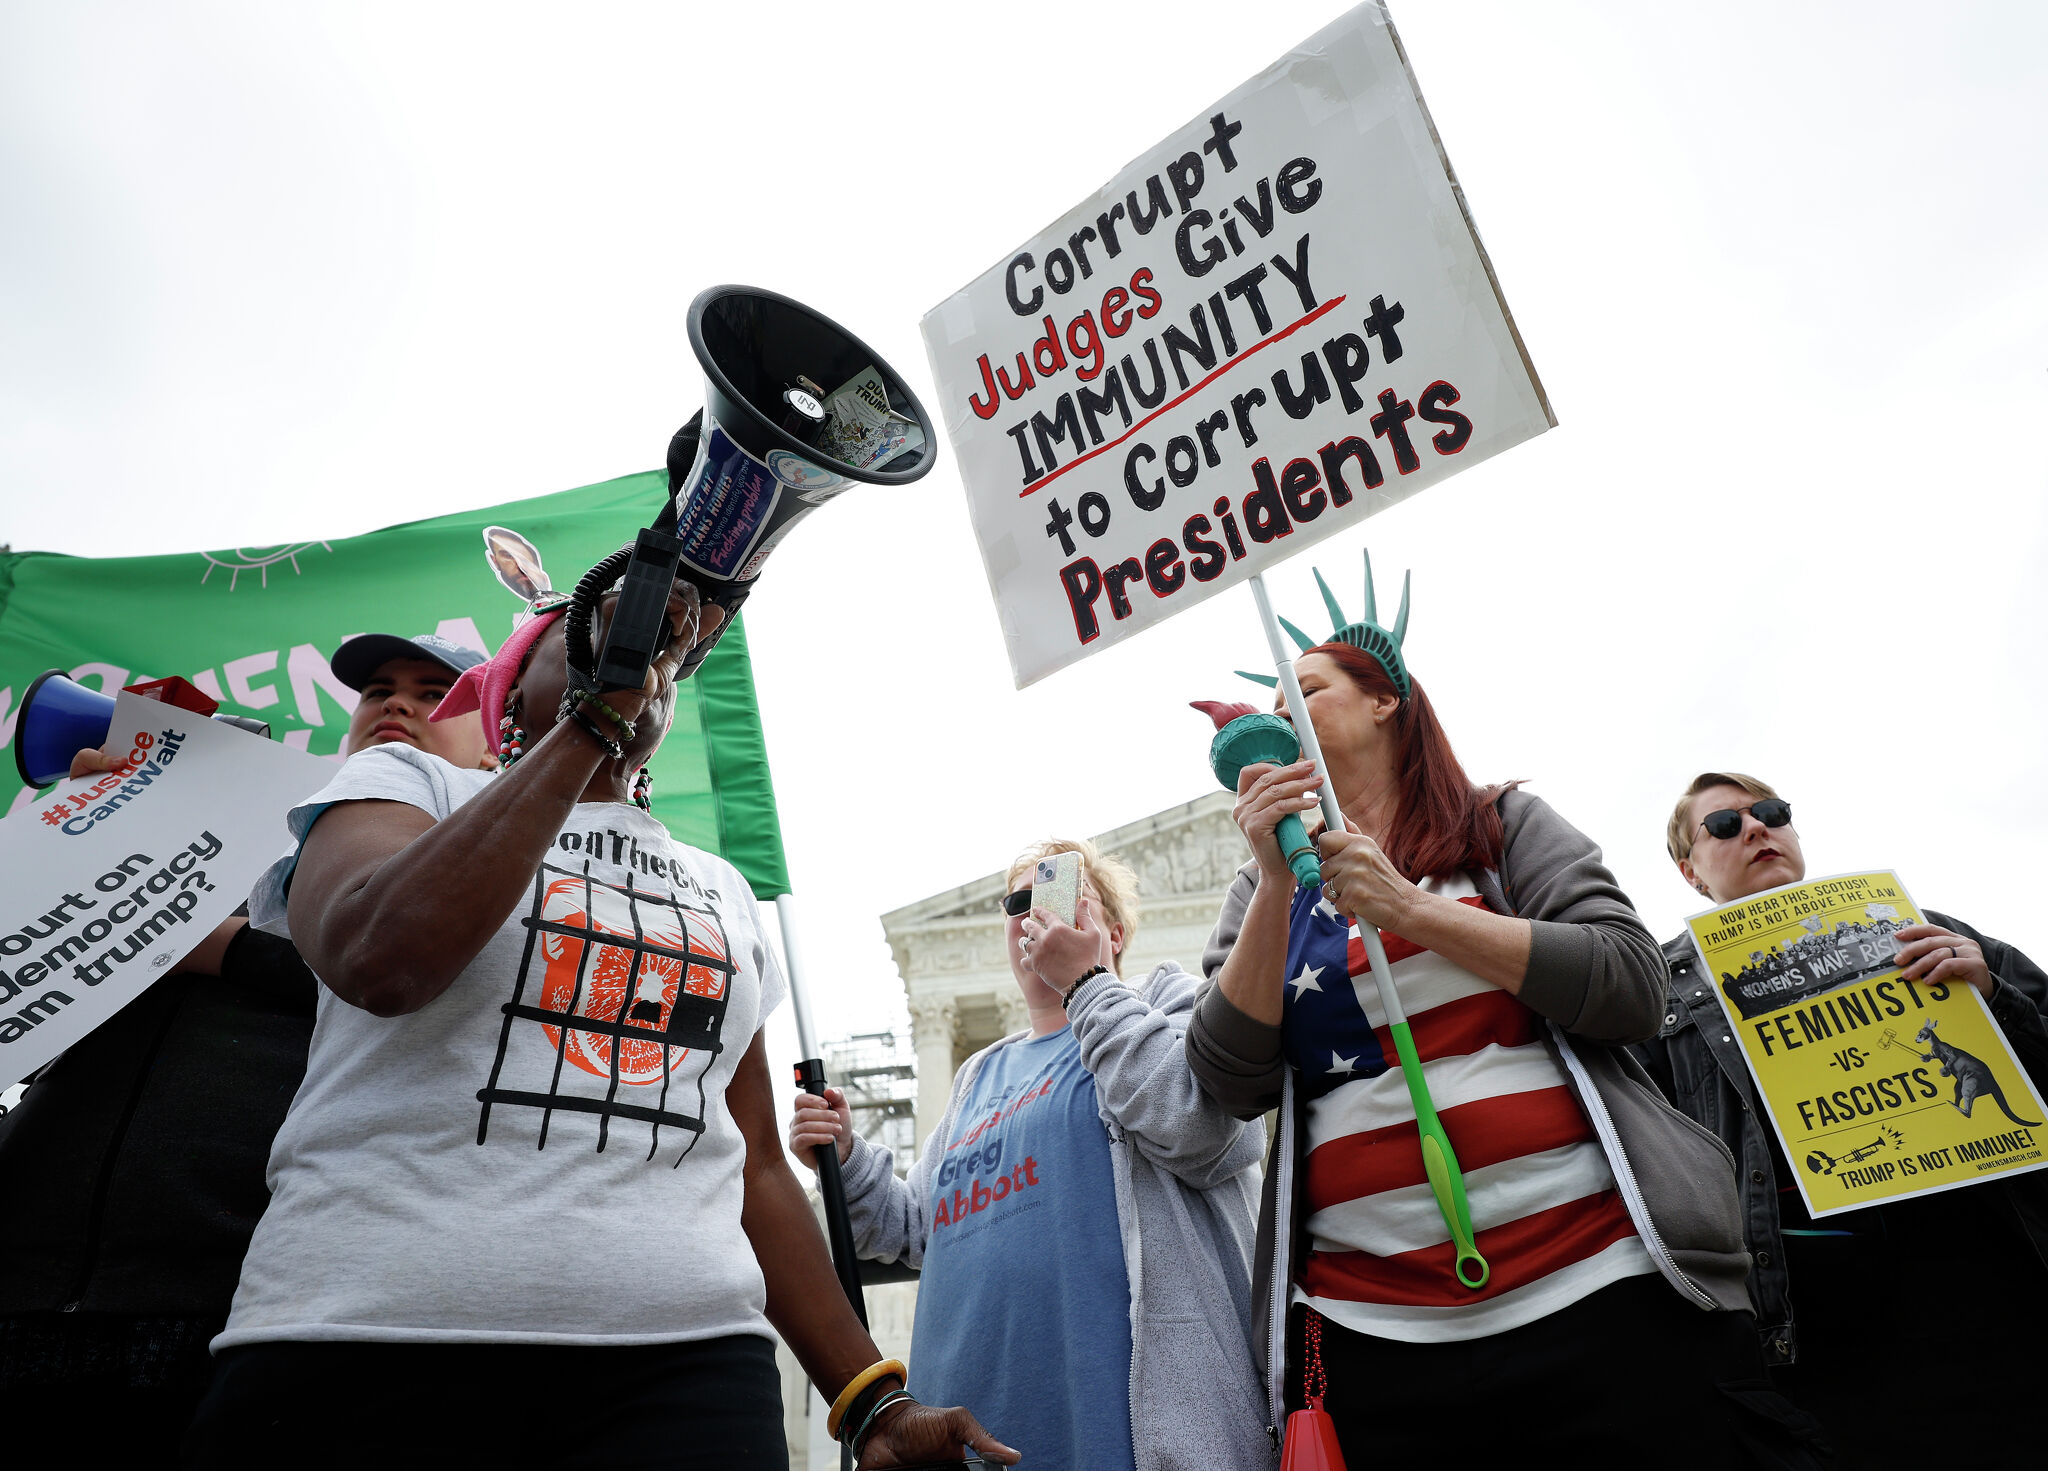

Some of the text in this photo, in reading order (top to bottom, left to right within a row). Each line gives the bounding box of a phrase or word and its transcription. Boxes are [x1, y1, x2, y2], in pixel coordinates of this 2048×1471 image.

[1004, 111, 1242, 316] Corrupt
[968, 155, 1324, 420] Judges Give
[1006, 233, 1318, 487] IMMUNITY
[1045, 293, 1405, 557] to Corrupt
[701, 471, 715, 496] MY
[1060, 378, 1473, 646] Presidents
[685, 515, 713, 554] TRANS
[710, 518, 752, 568] Fucking
[61, 728, 186, 836] CantWait
[0, 853, 154, 962] ourt on
[72, 870, 216, 987] trump?
[1704, 887, 1897, 946] TRUMP IS NOT ABOVE THE LAW
[1719, 911, 1746, 926] NOW
[1749, 900, 1780, 919] HEAR
[1814, 878, 1869, 896] SCOTUS!!
[1739, 968, 1805, 999] WOMEN'S
[1807, 948, 1852, 979] WAVE
[1828, 1046, 1871, 1073] -VS-
[1796, 1067, 1938, 1131] FASCISTS
[938, 1138, 1002, 1187] Greg
[1837, 1128, 2036, 1190] TRUMP IS NOT IMMUNE!
[1976, 1150, 2043, 1172] WOMENSMARCH.COM
[933, 1155, 1039, 1233] Abbott
